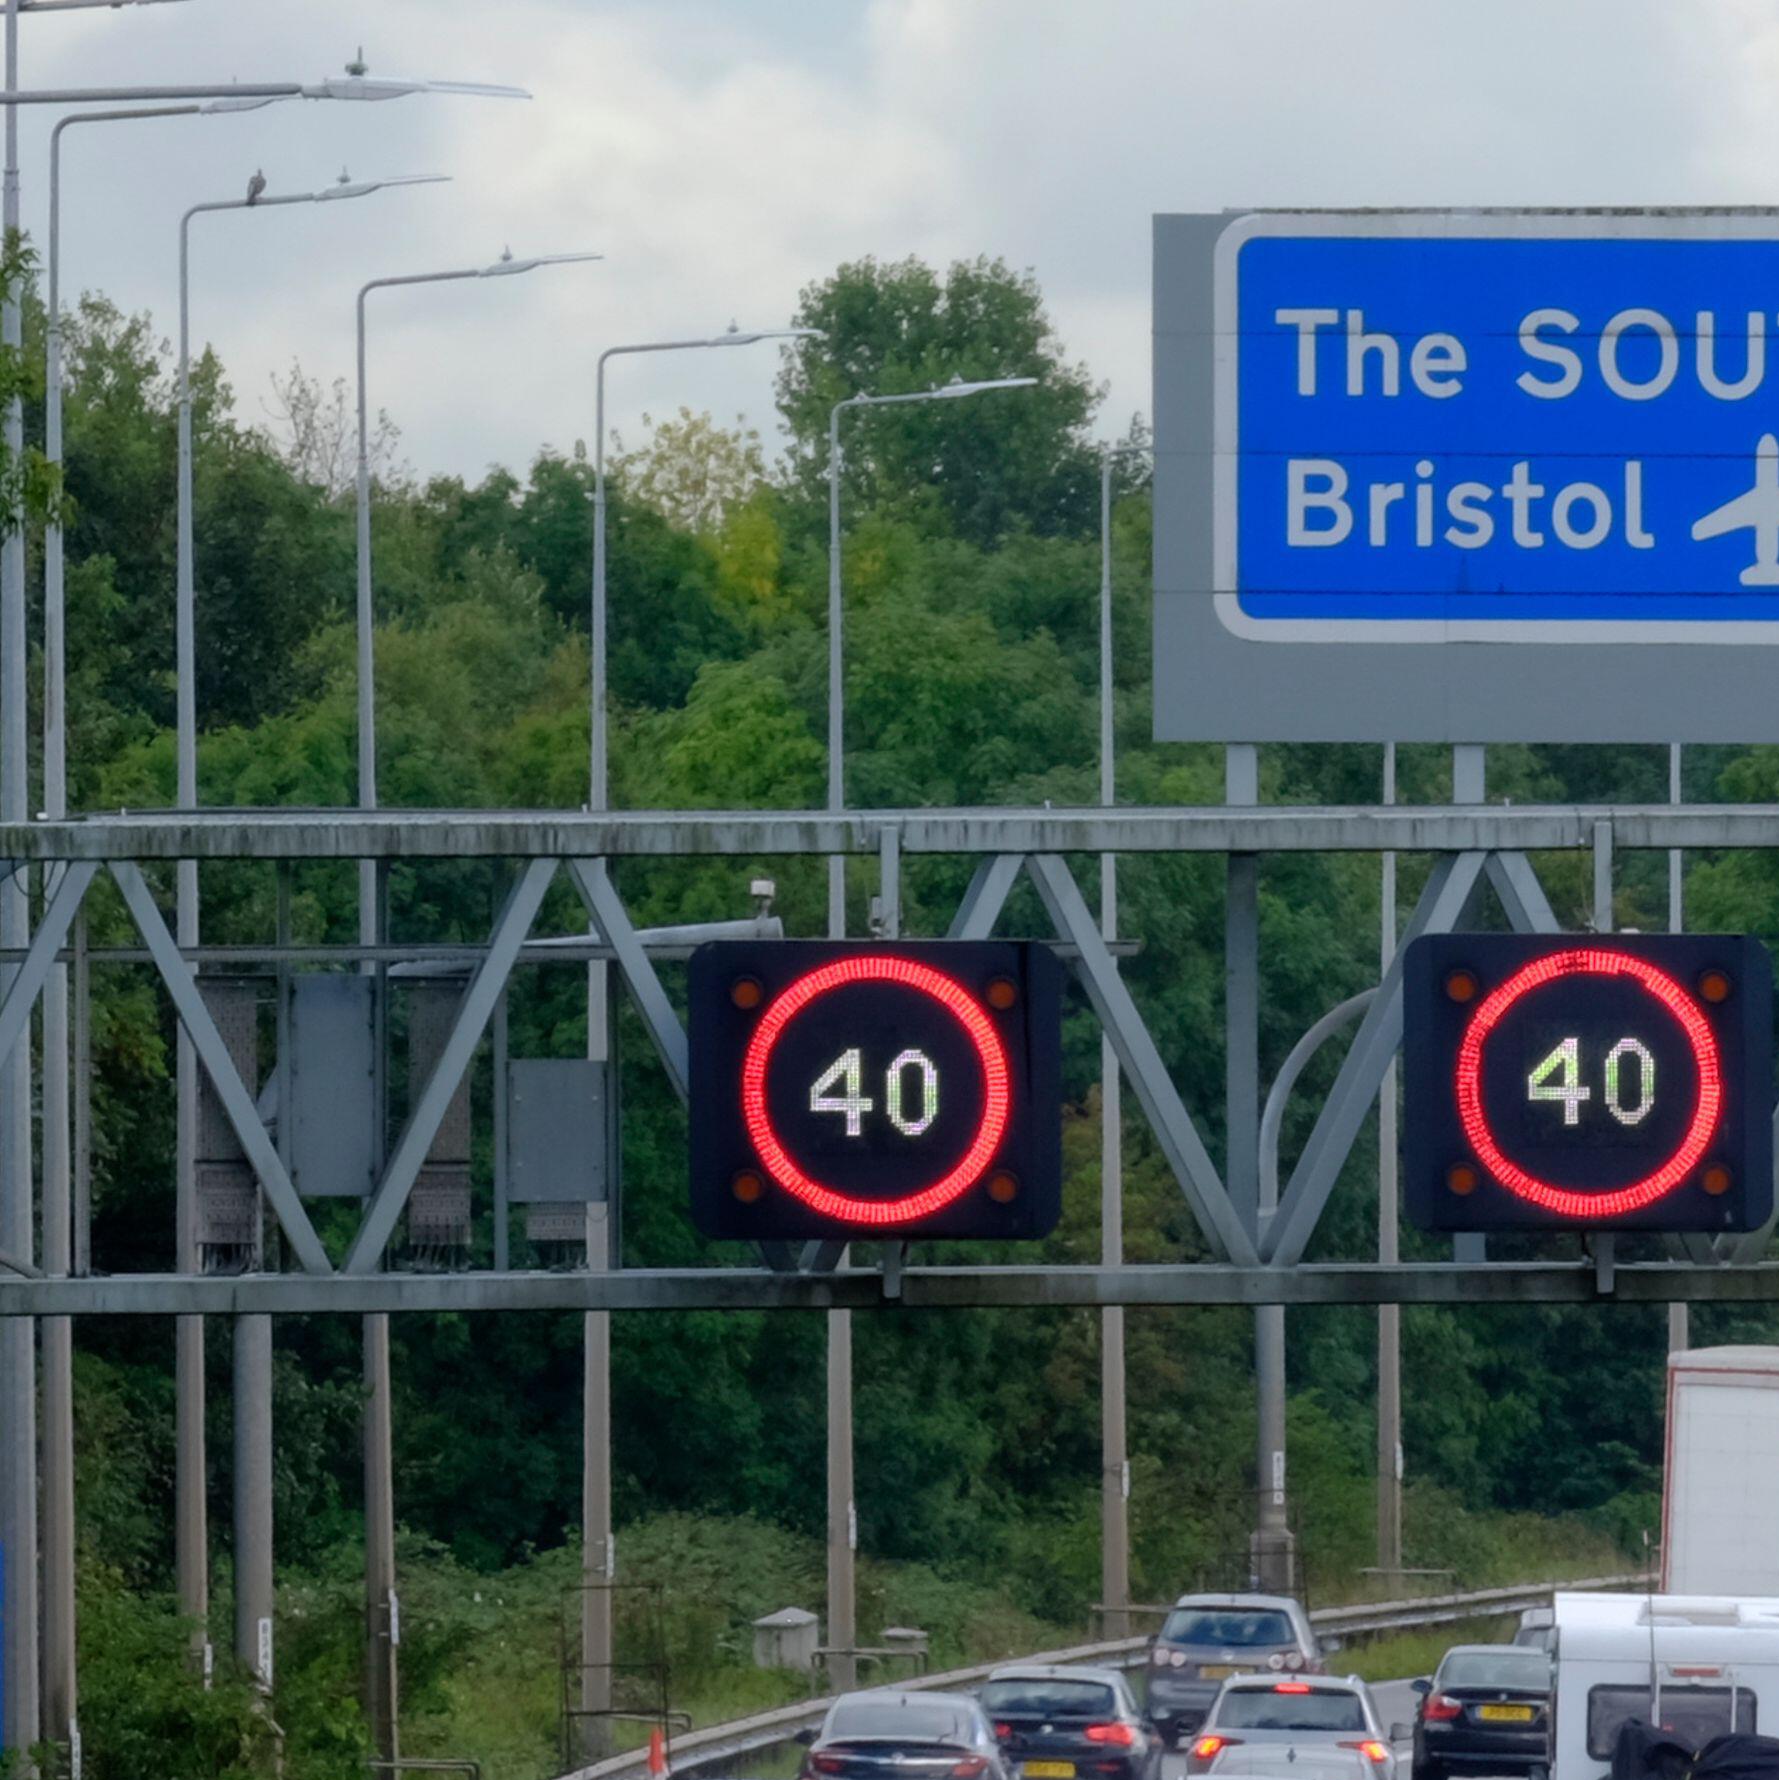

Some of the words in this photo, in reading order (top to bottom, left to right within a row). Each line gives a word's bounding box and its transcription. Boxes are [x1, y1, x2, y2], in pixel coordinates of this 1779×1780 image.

[1276, 309, 1466, 398] The
[1287, 459, 1654, 549] Bristol
[809, 1049, 938, 1137] 40
[1527, 1038, 1655, 1125] 40
